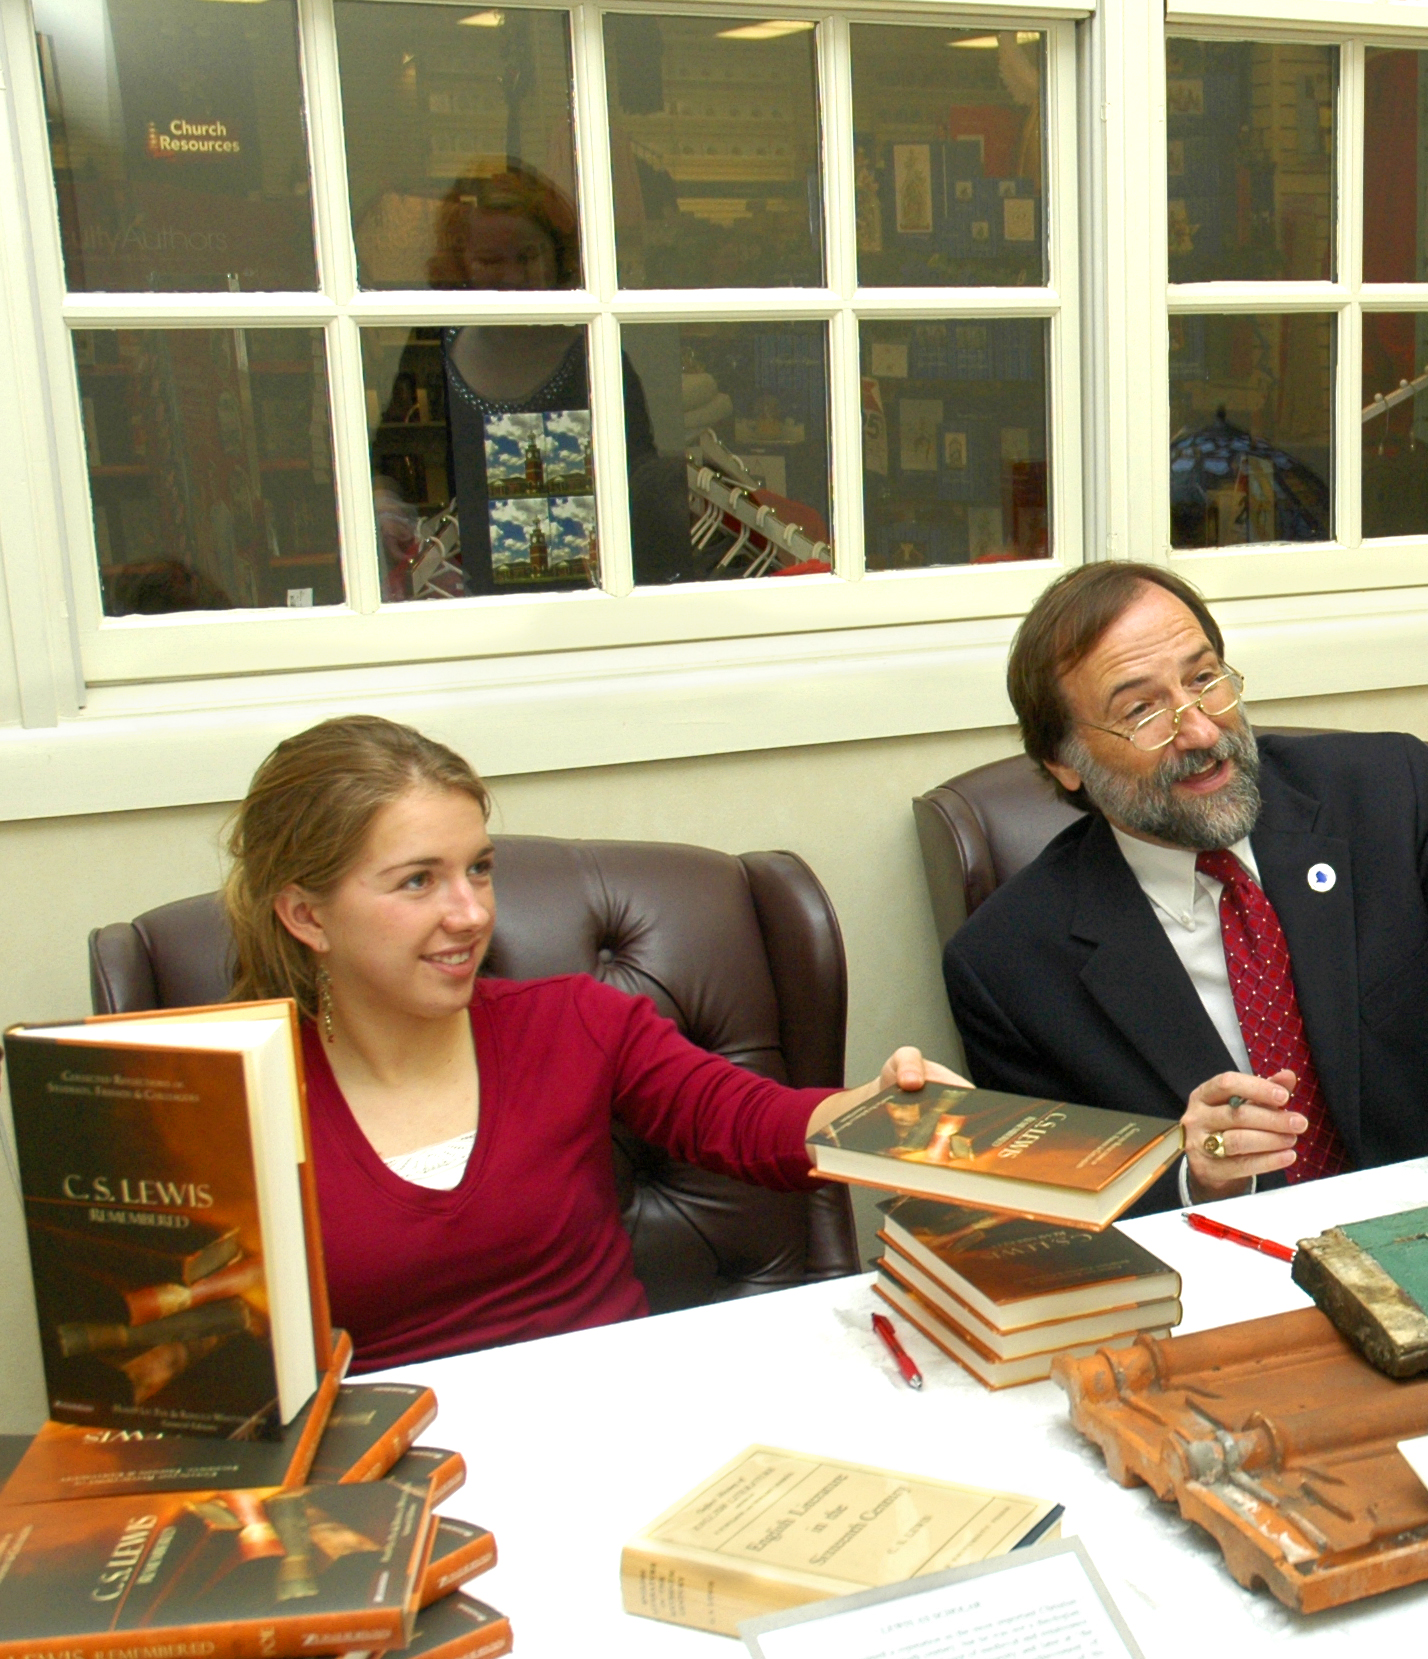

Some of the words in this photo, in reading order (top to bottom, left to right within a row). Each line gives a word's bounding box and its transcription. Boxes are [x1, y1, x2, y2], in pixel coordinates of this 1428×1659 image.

[170, 119, 227, 136] Church
[159, 135, 240, 152] Resources
[121, 1178, 213, 1209] LEWIS
[106, 1514, 158, 1568] LEWIS
